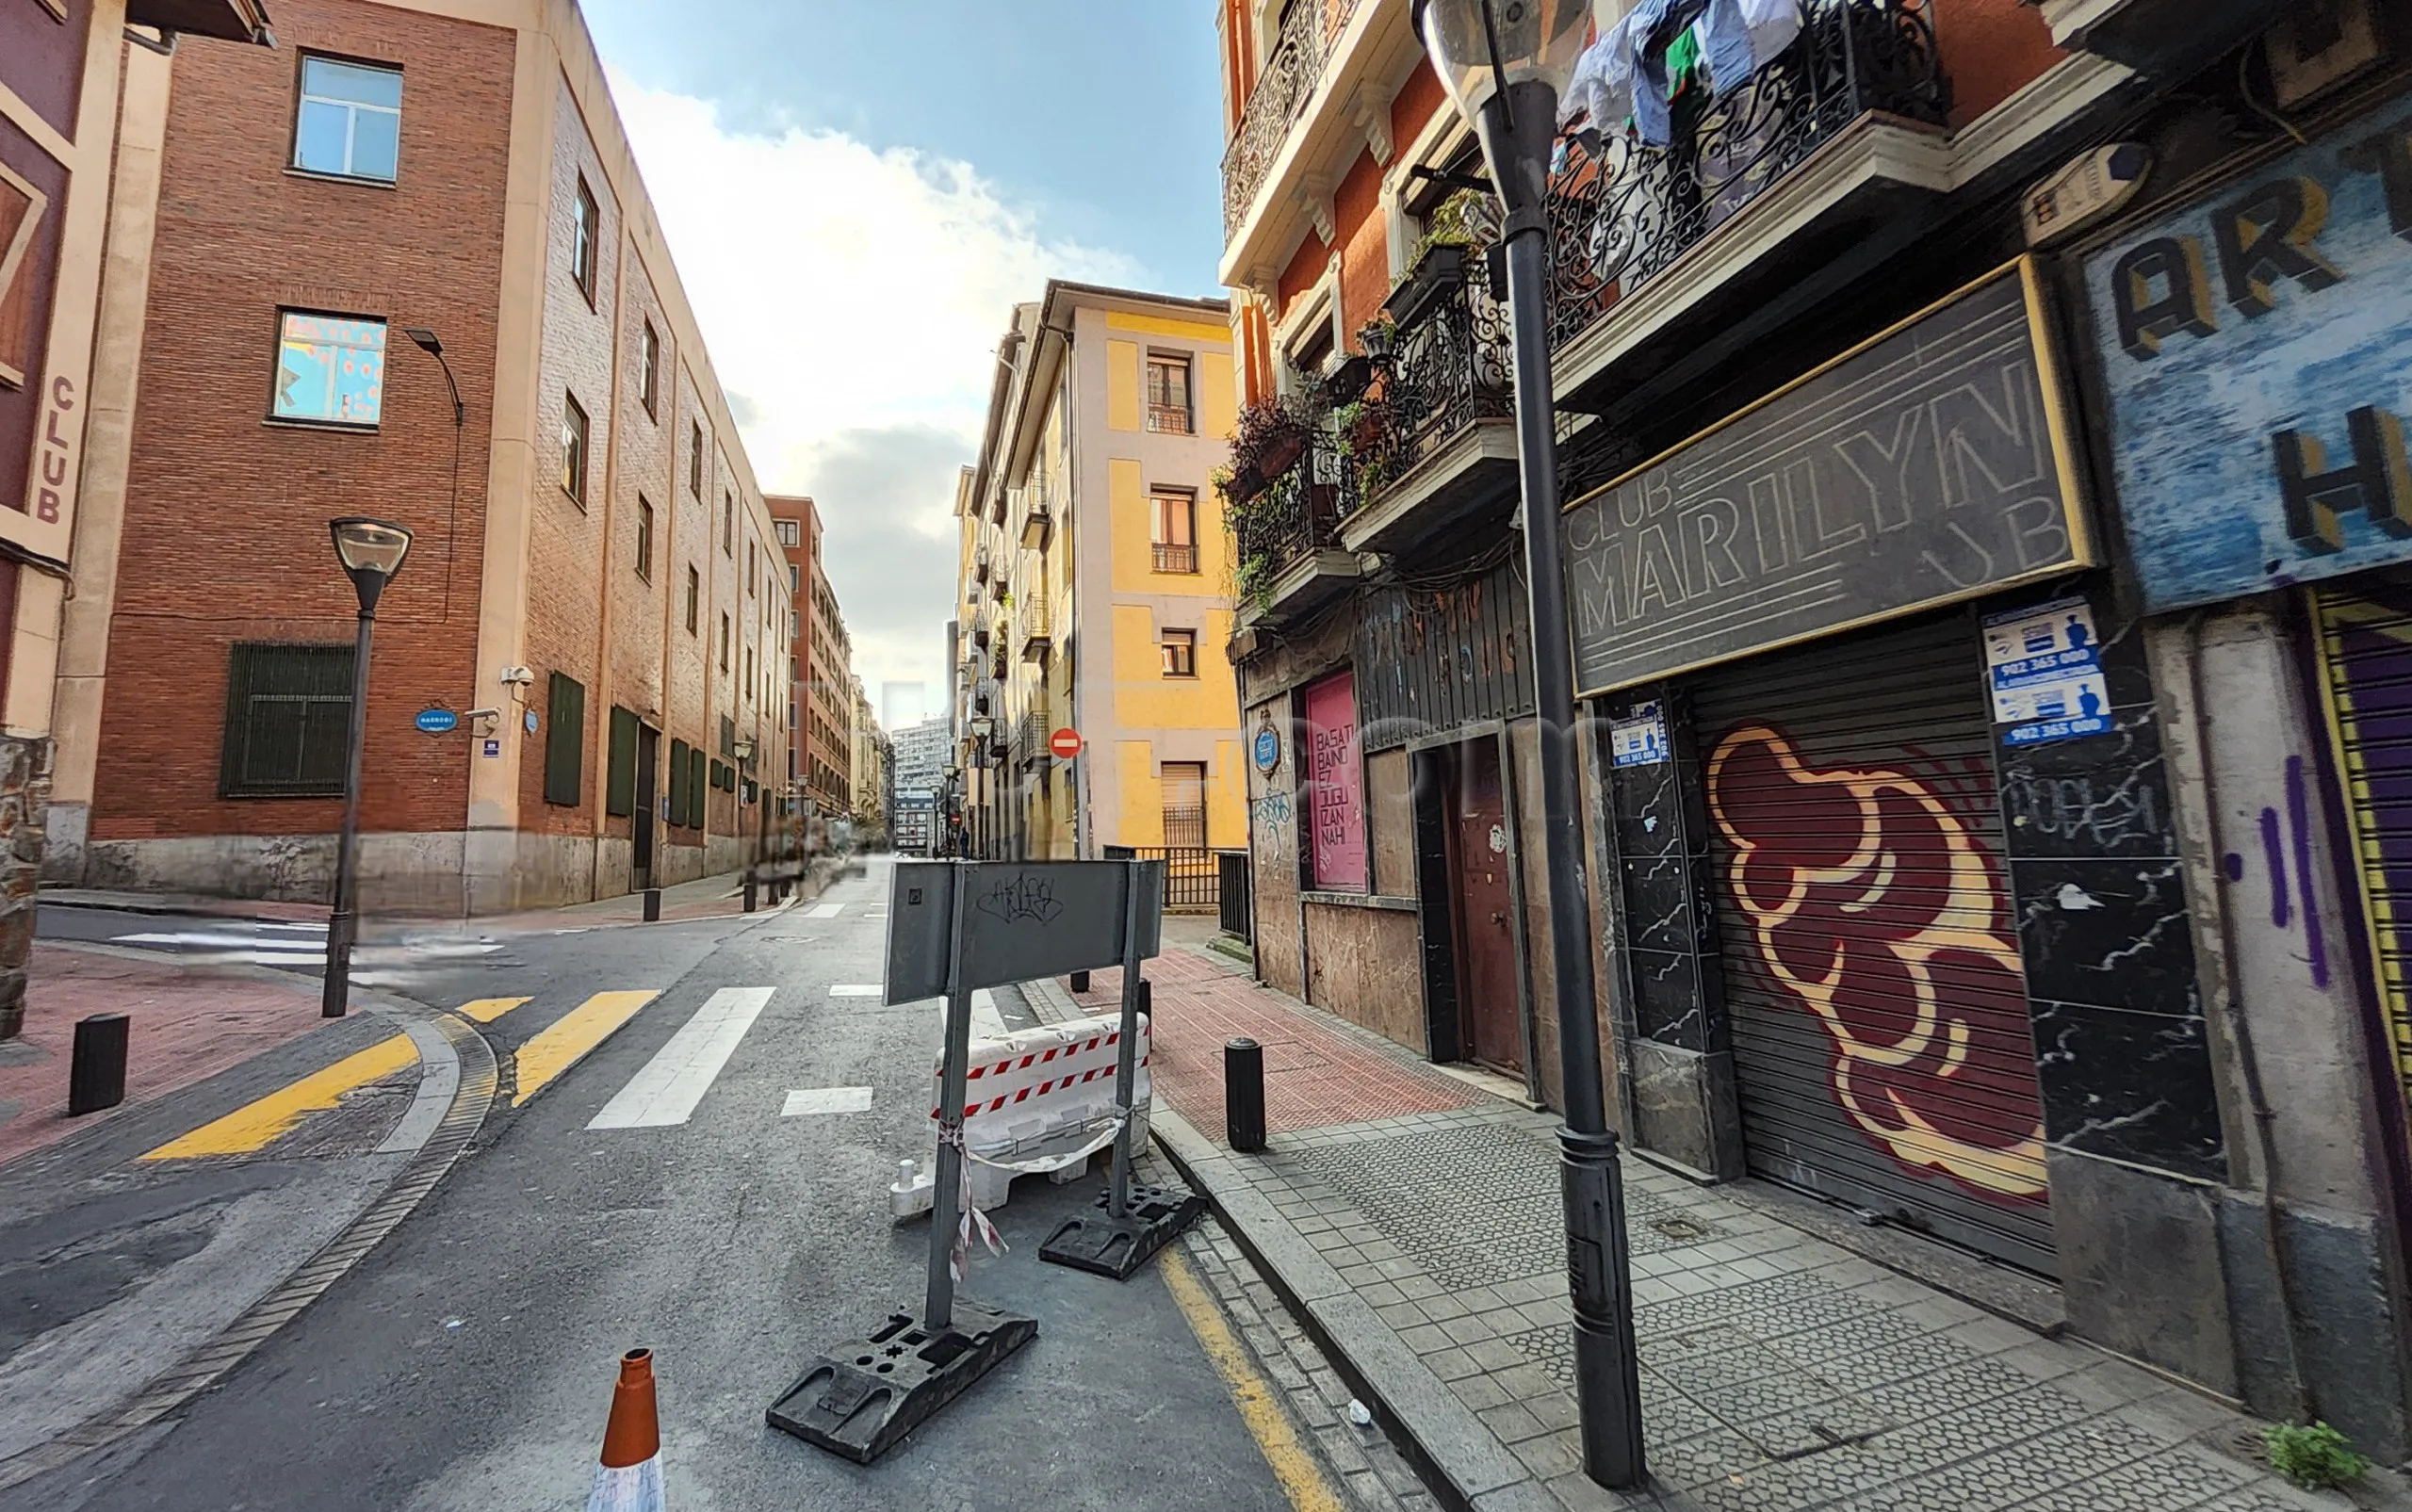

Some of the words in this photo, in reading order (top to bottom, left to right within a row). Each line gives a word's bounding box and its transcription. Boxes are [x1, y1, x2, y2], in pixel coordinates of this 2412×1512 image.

[37, 376, 73, 525] CLUB
[1567, 471, 1674, 551] CLUB
[1573, 358, 2045, 639] MARILYN
[1318, 746, 1348, 771] BAINO
[1319, 770, 1332, 789] EZ
[1321, 807, 1345, 827] IZAN
[1321, 826, 1345, 847] NAHI
